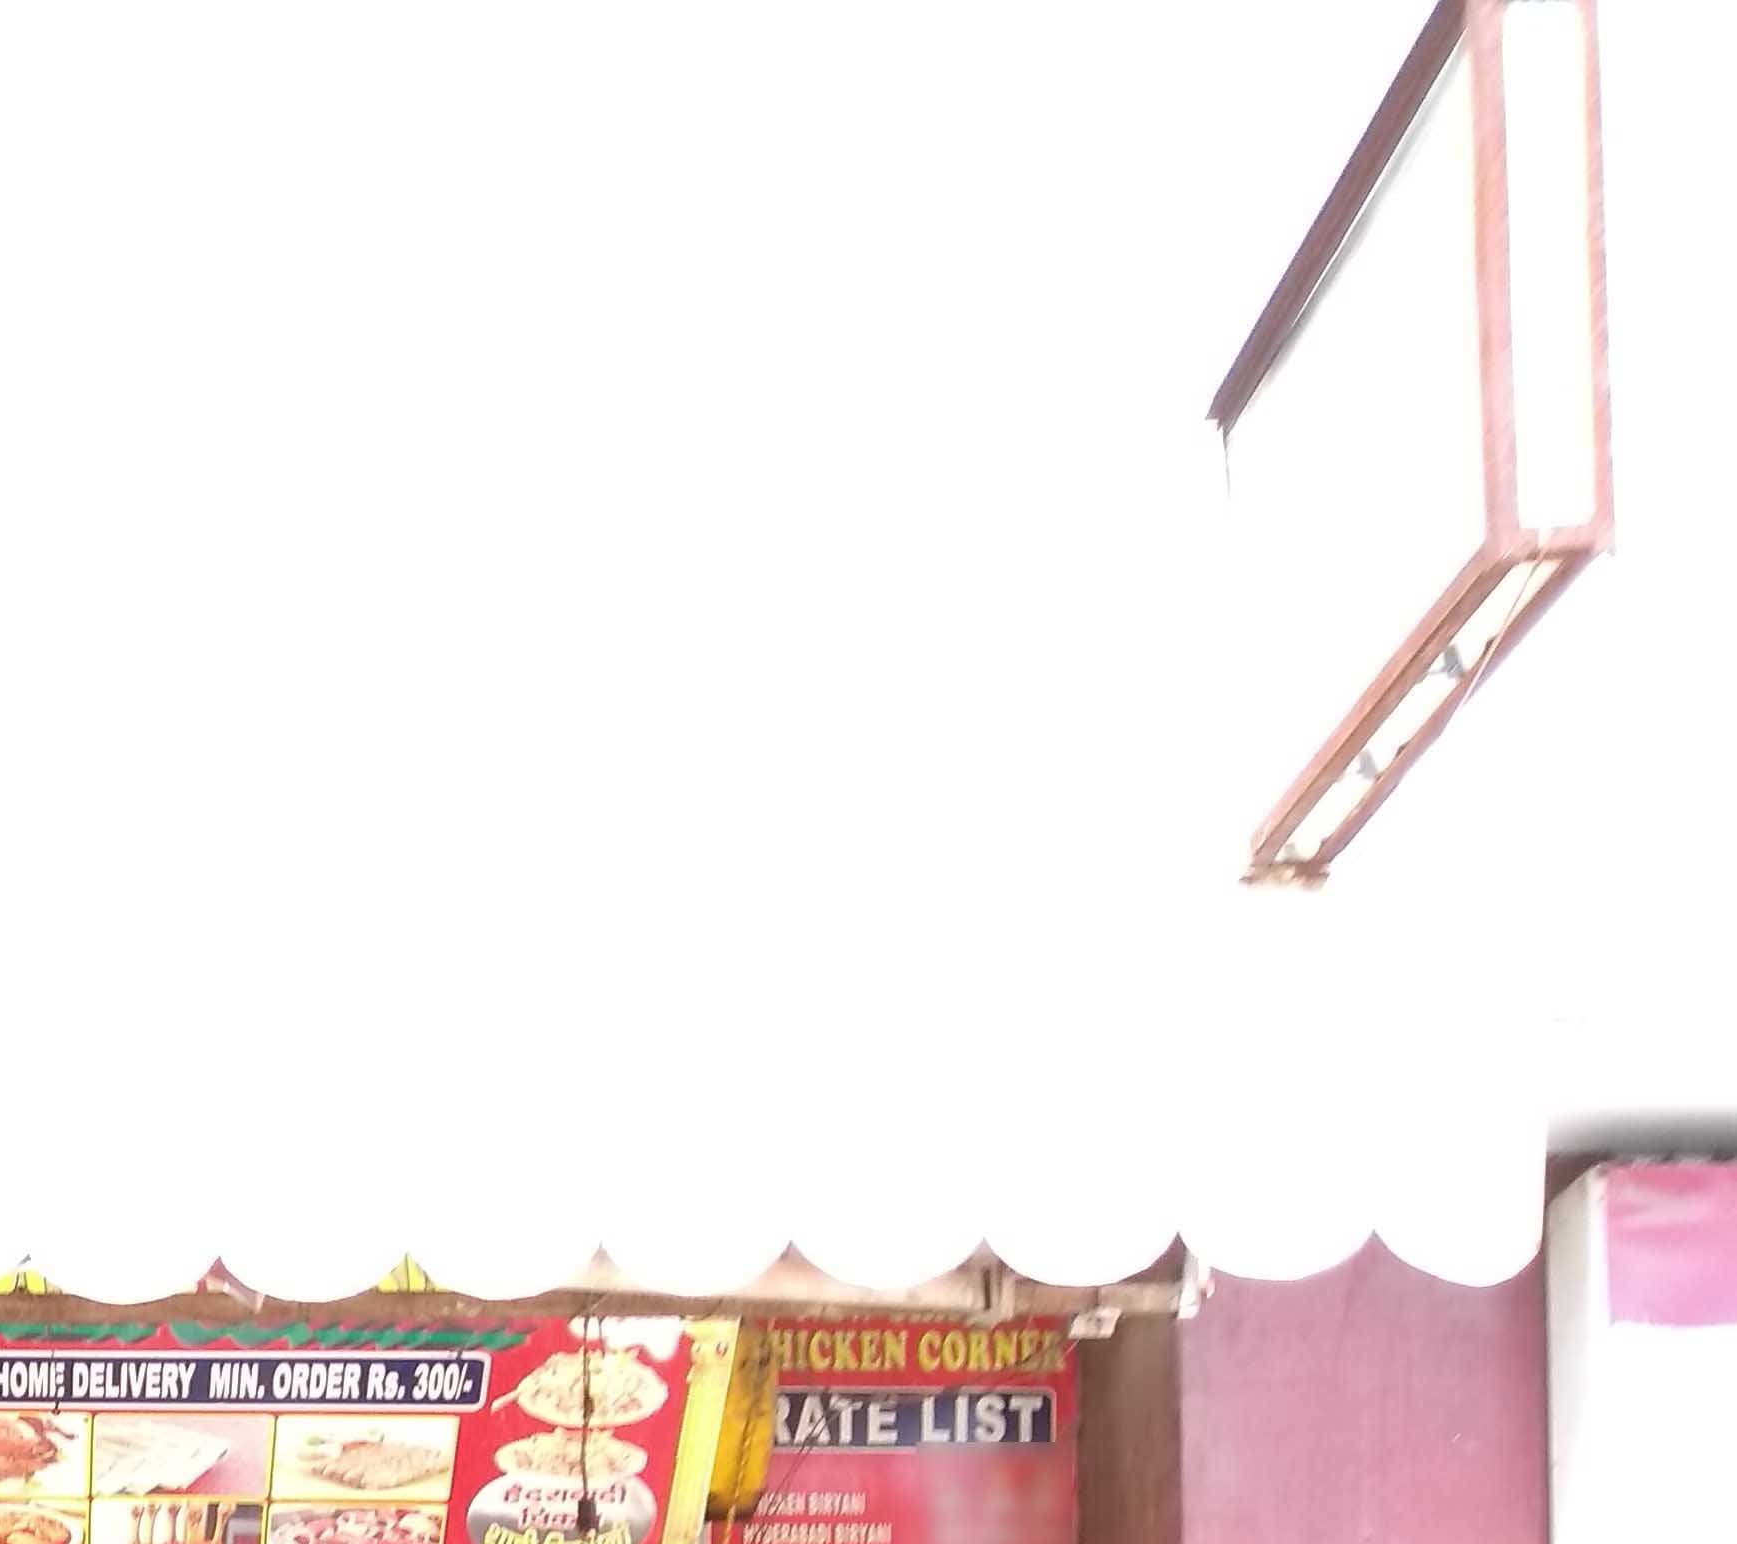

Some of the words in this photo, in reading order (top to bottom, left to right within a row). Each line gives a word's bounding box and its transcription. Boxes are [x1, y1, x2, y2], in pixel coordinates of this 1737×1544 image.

[771, 1329, 908, 1371] HICKEN
[916, 1329, 1065, 1371] CORNER
[72, 1362, 193, 1400] DELIVERY
[209, 1364, 265, 1401] MIN.
[273, 1364, 361, 1401] ORDER
[367, 1365, 405, 1402] Rs.
[412, 1364, 475, 1402] 300/-
[773, 1393, 900, 1445] RATE
[920, 1393, 1044, 1443] LIST
[807, 1492, 866, 1516] BIRYANI
